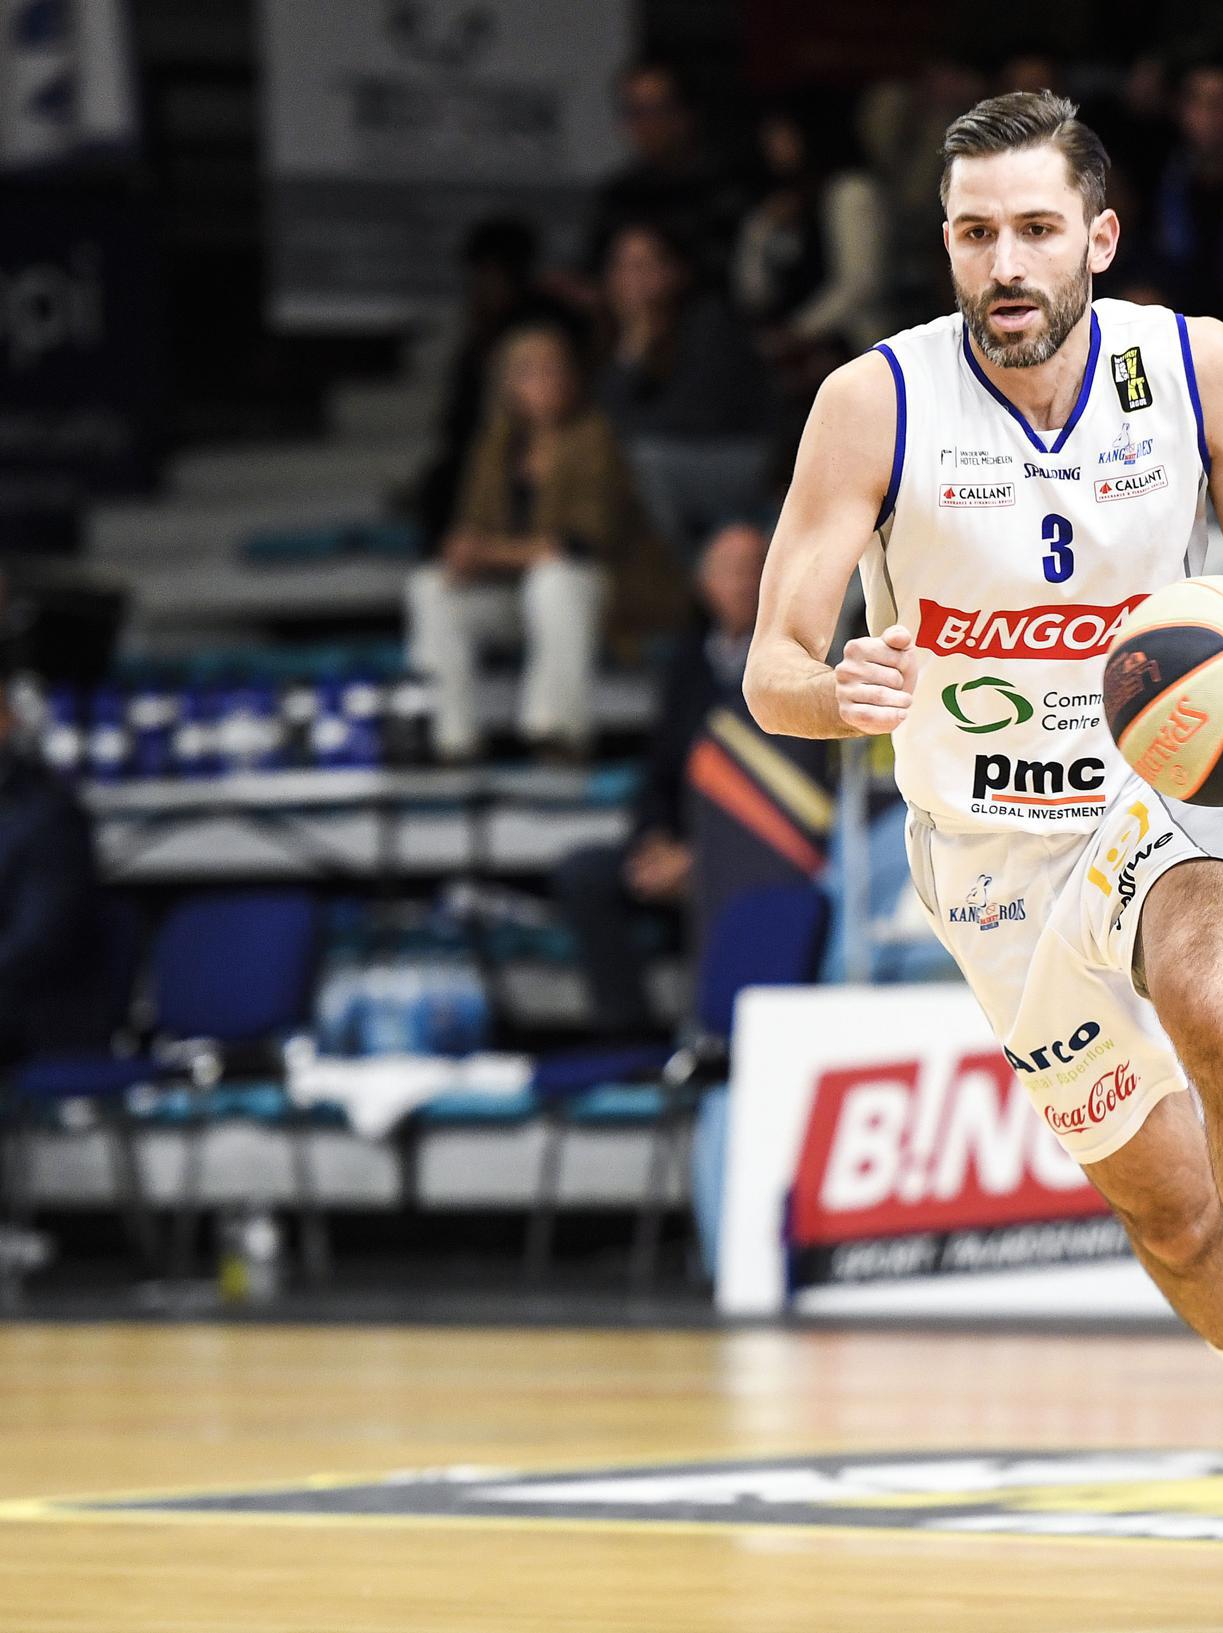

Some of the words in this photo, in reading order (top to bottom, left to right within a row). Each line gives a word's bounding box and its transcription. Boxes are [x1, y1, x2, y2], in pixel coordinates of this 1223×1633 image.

[960, 457, 980, 466] HOTEL
[1023, 463, 1081, 480] SPALDING
[1115, 469, 1162, 492] CALLANT
[959, 486, 1012, 500] CALLANT
[1041, 513, 1075, 584] 3
[1042, 714, 1100, 731] Centre
[972, 754, 1105, 800] pmc
[971, 803, 1025, 818] GLOBAL
[1028, 806, 1106, 820] INVESTMENT
[1004, 1021, 1101, 1073] Arco
[1044, 1059, 1121, 1135] Coca-Cola
